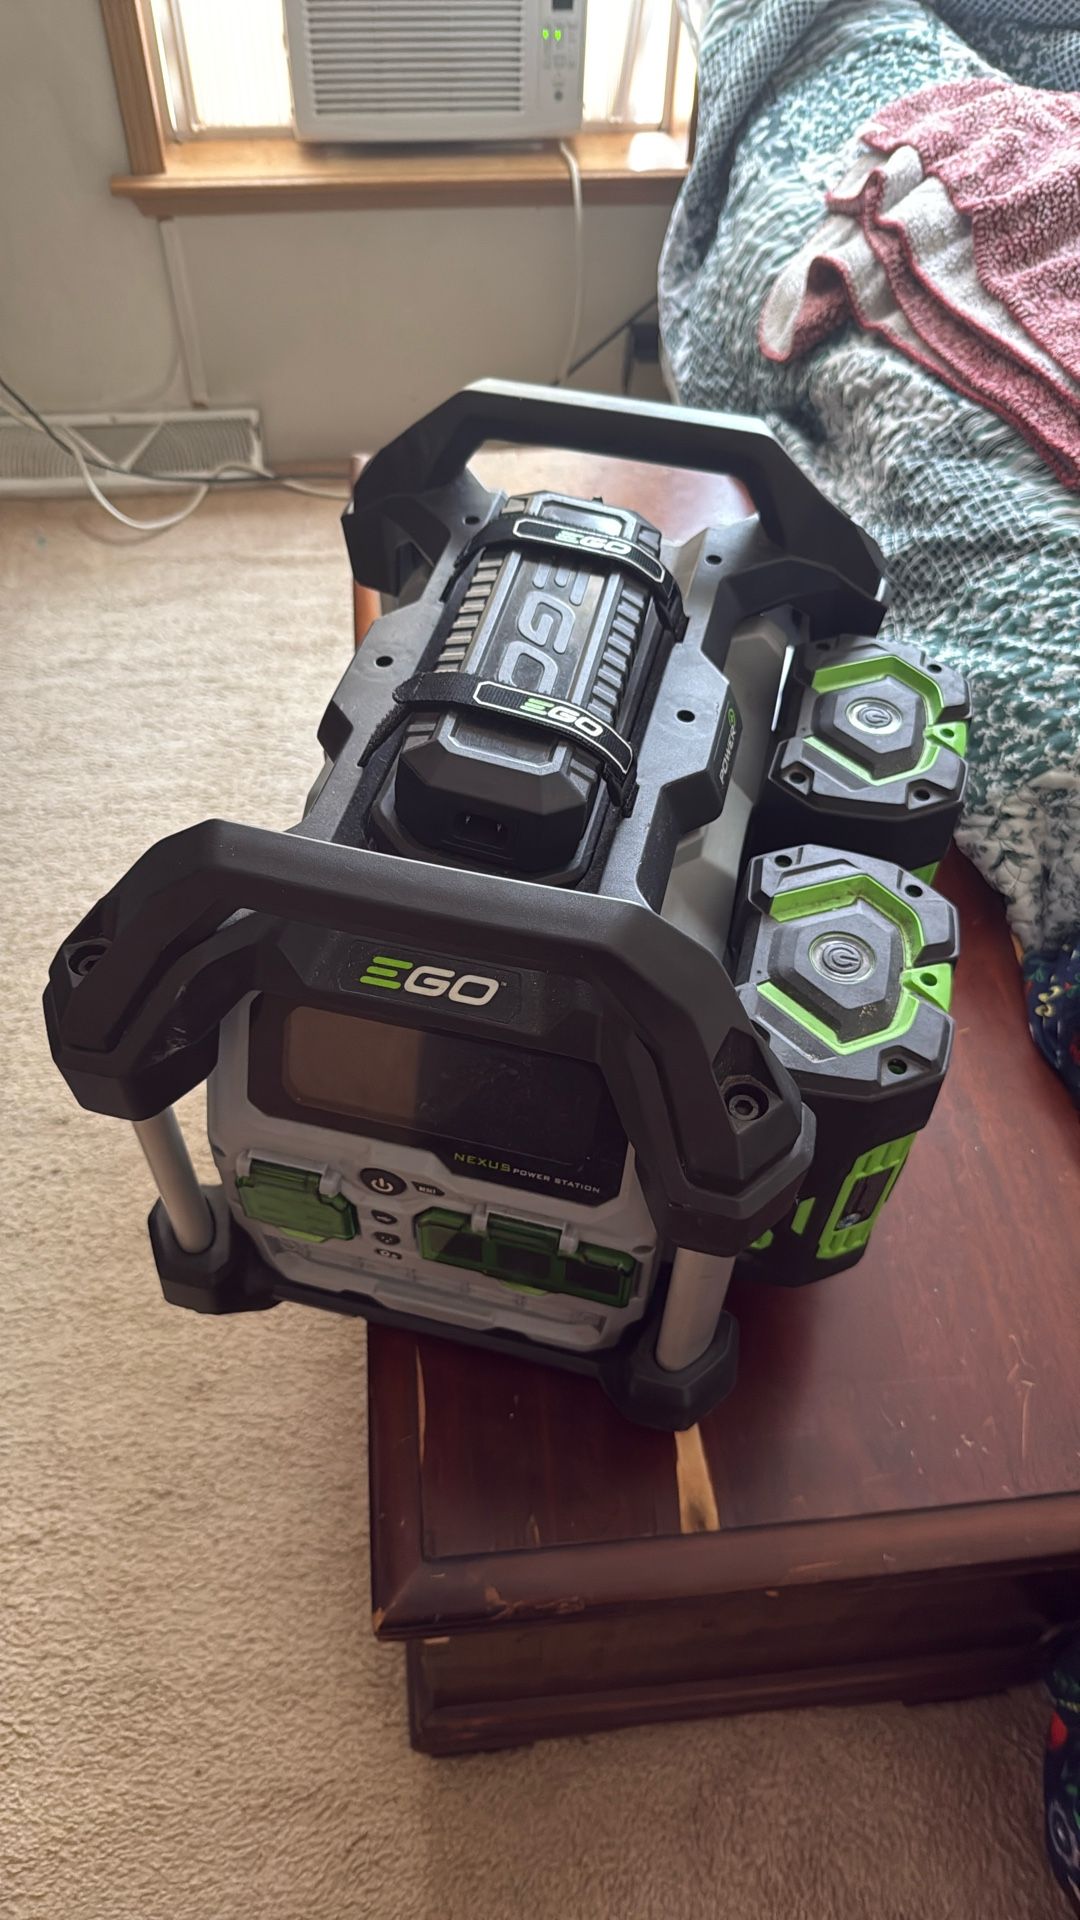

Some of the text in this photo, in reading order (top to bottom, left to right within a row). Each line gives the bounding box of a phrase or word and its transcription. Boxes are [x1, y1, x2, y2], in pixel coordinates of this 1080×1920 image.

[555, 530, 632, 555] EGO
[520, 698, 604, 737] EGO
[719, 725, 736, 785] POWER
[360, 956, 500, 1006] EGO
[454, 1153, 600, 1194] NEXUS POWER STATION
